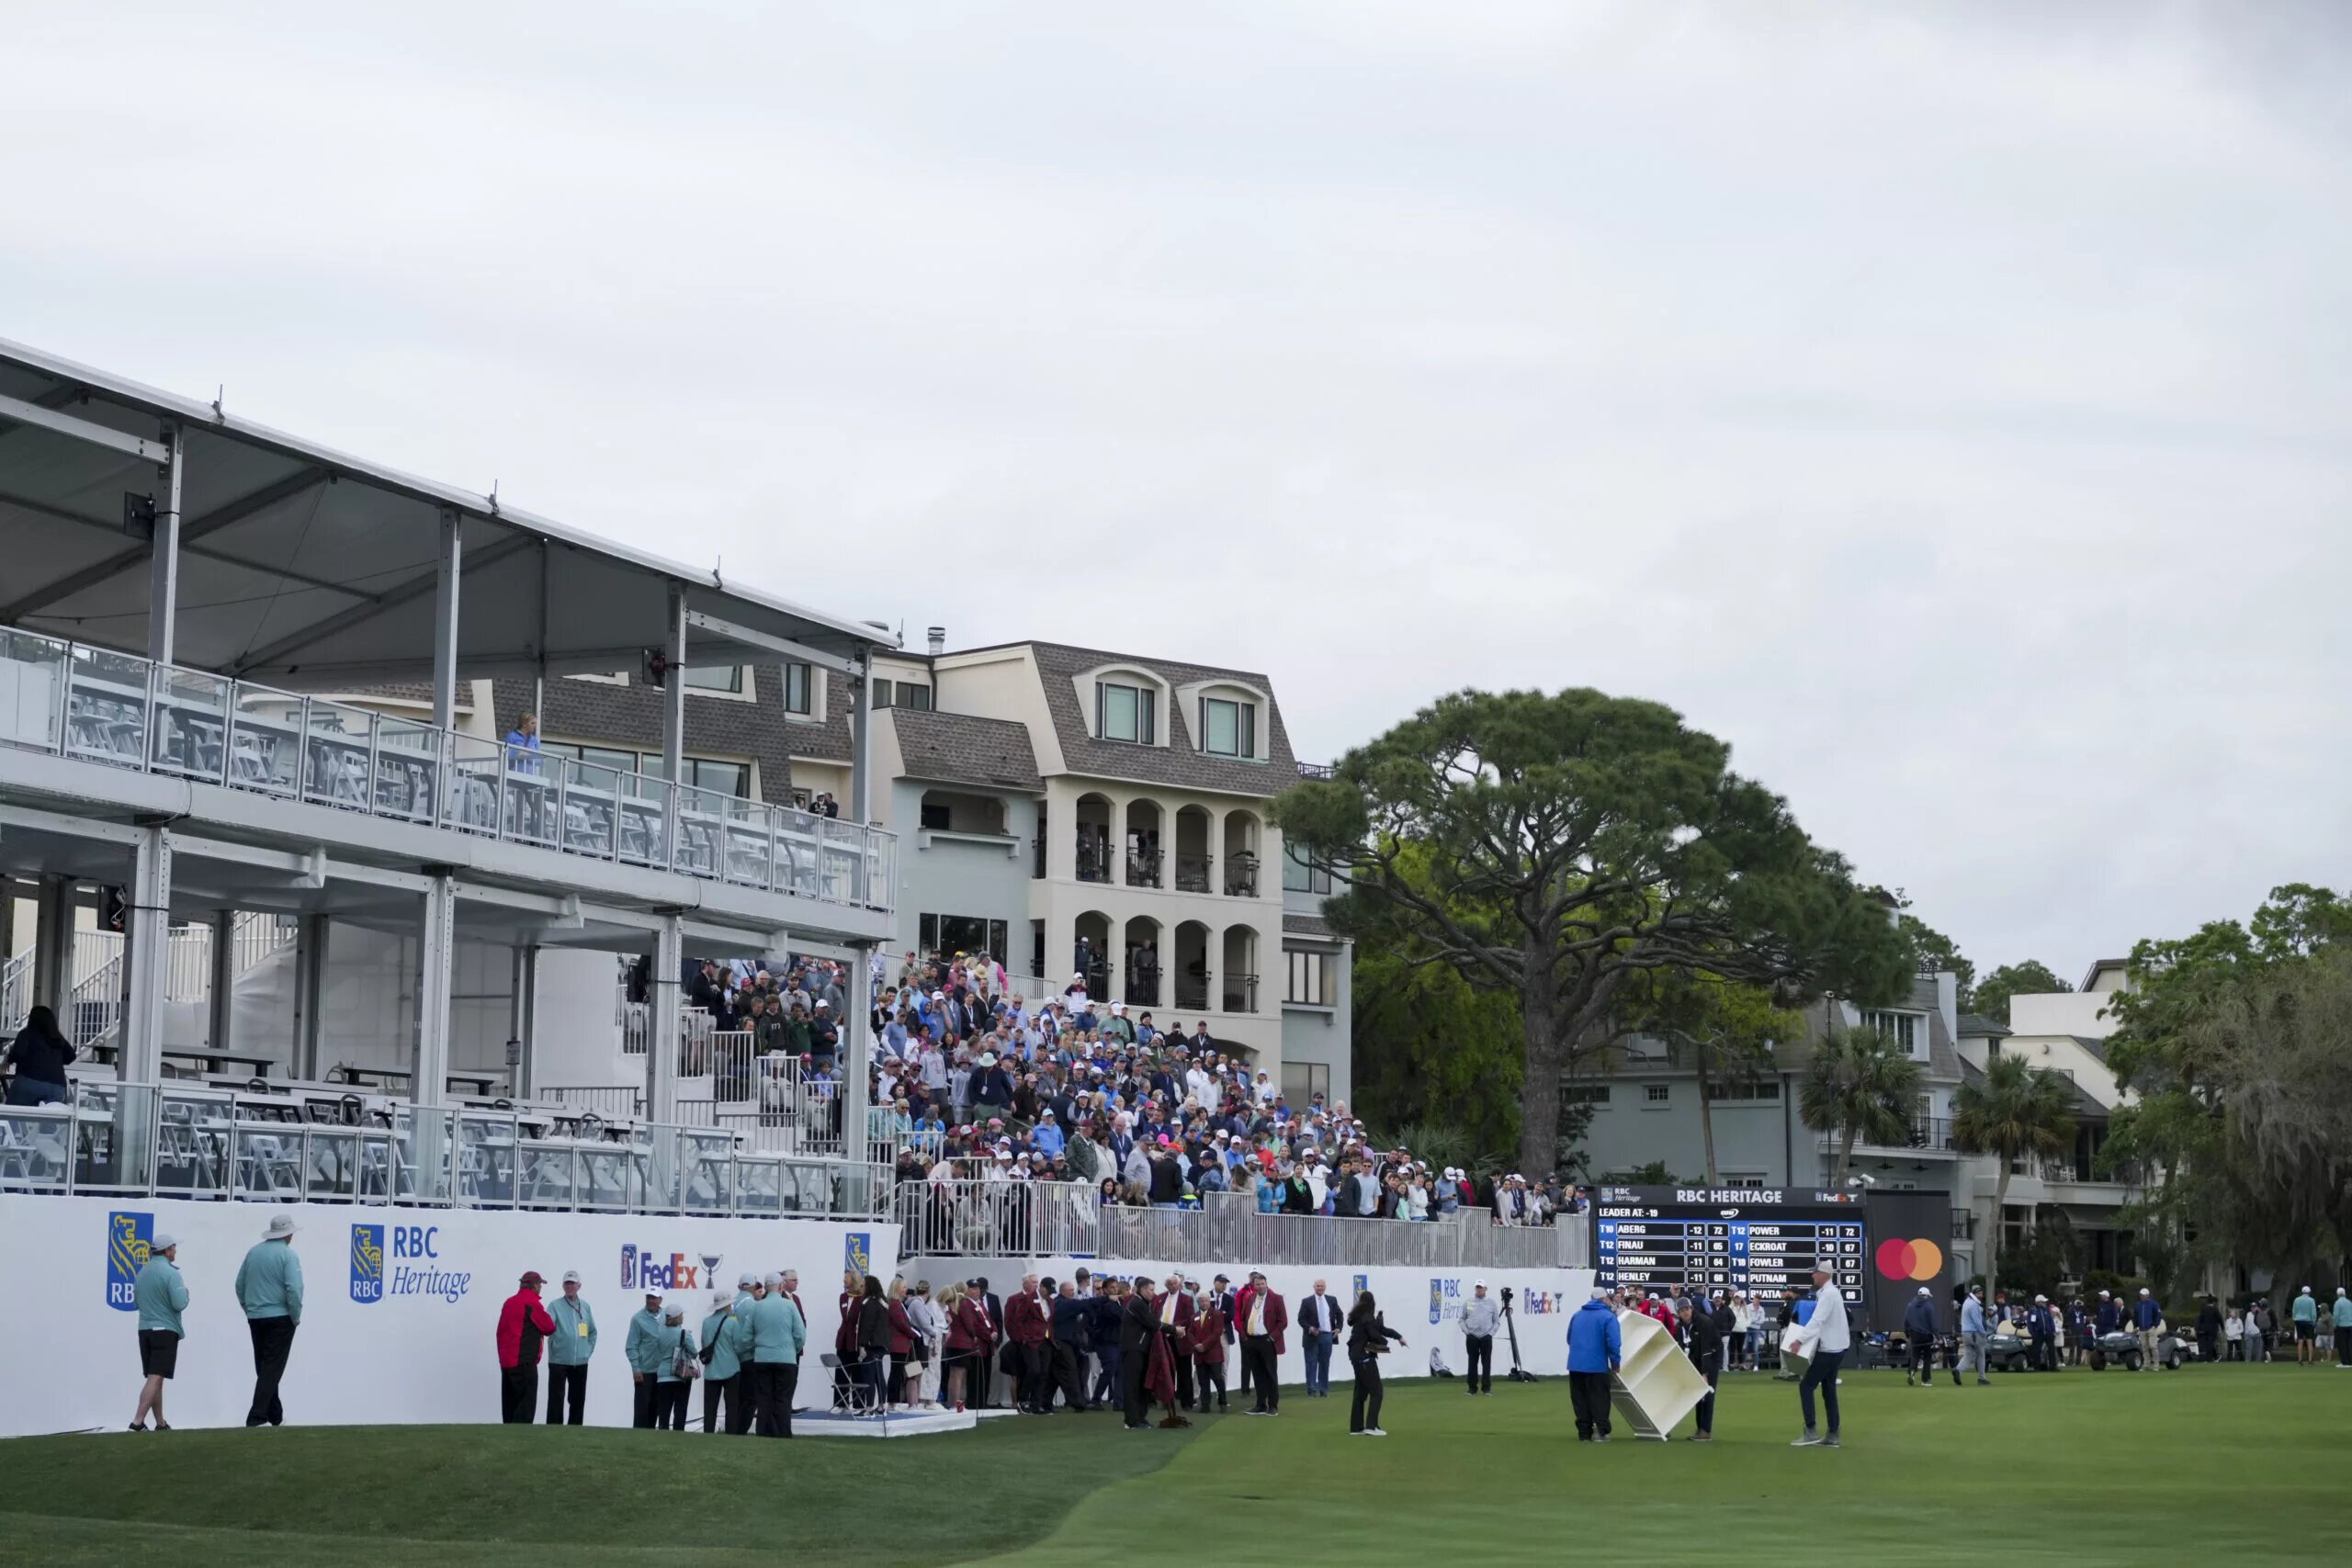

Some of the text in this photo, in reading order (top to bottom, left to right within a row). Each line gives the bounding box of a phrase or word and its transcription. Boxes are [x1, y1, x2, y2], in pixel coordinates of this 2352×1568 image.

[1677, 1190, 1782, 1203] RBC HERITAGE
[1823, 1194, 1848, 1202] FedEx
[1599, 1208, 1630, 1217] LEADER
[1632, 1209, 1644, 1217] AT:
[1600, 1225, 1723, 1235] T10 ABERG -12 72
[1731, 1226, 1746, 1235] T12
[1750, 1227, 1780, 1235] POWER
[394, 1226, 438, 1258] RBC
[1600, 1241, 1614, 1249] T12
[1618, 1241, 1643, 1249] FINAU
[1690, 1242, 1702, 1250] -11
[1735, 1242, 1743, 1251] 17
[1750, 1243, 1787, 1251] ECKROAT
[1822, 1243, 1834, 1251] -10
[1600, 1256, 1723, 1266] T12 HARMAN -11 64
[1750, 1258, 1783, 1267] FOWLER
[1845, 1259, 1855, 1268] 67
[640, 1252, 698, 1290] FedEx
[1600, 1272, 1614, 1280] T12
[1618, 1273, 1650, 1281] HENLEY
[1690, 1274, 1703, 1282] -11
[1750, 1274, 1787, 1283] PUTNAM
[1846, 1275, 1855, 1284] 67
[391, 1264, 471, 1303] Heritage
[1444, 1279, 1460, 1297] RBC
[111, 1282, 135, 1303] RB
[353, 1281, 380, 1297] RBC
[1531, 1292, 1553, 1314] FedEx
